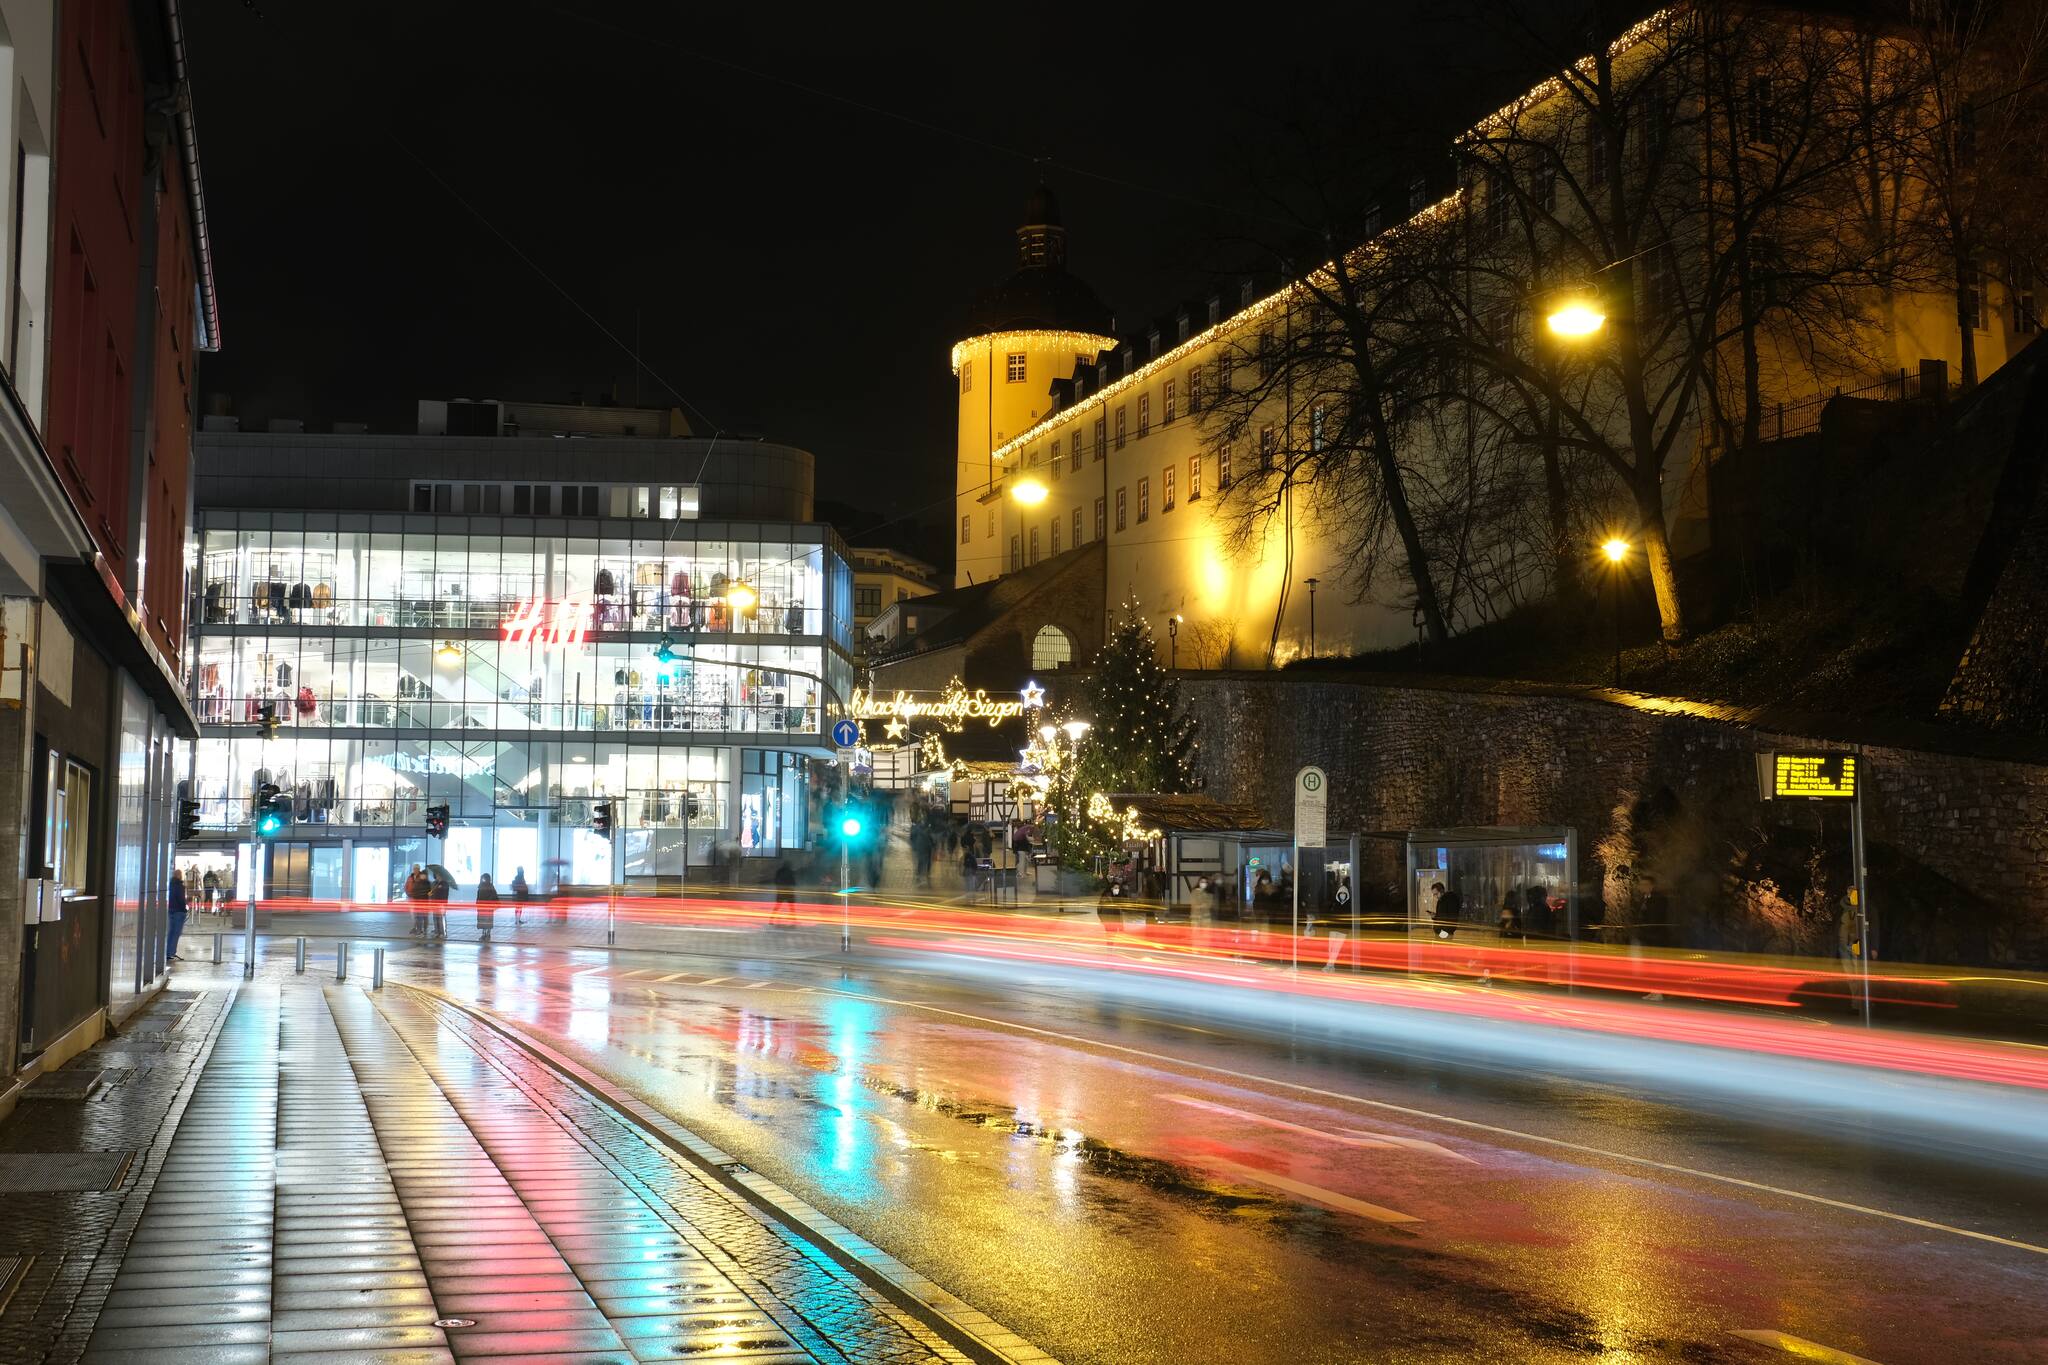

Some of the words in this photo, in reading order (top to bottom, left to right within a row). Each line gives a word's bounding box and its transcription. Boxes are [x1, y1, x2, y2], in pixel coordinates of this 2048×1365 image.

[501, 596, 594, 651] H&M
[965, 689, 1023, 727] Siegen
[1308, 776, 1316, 787] H
